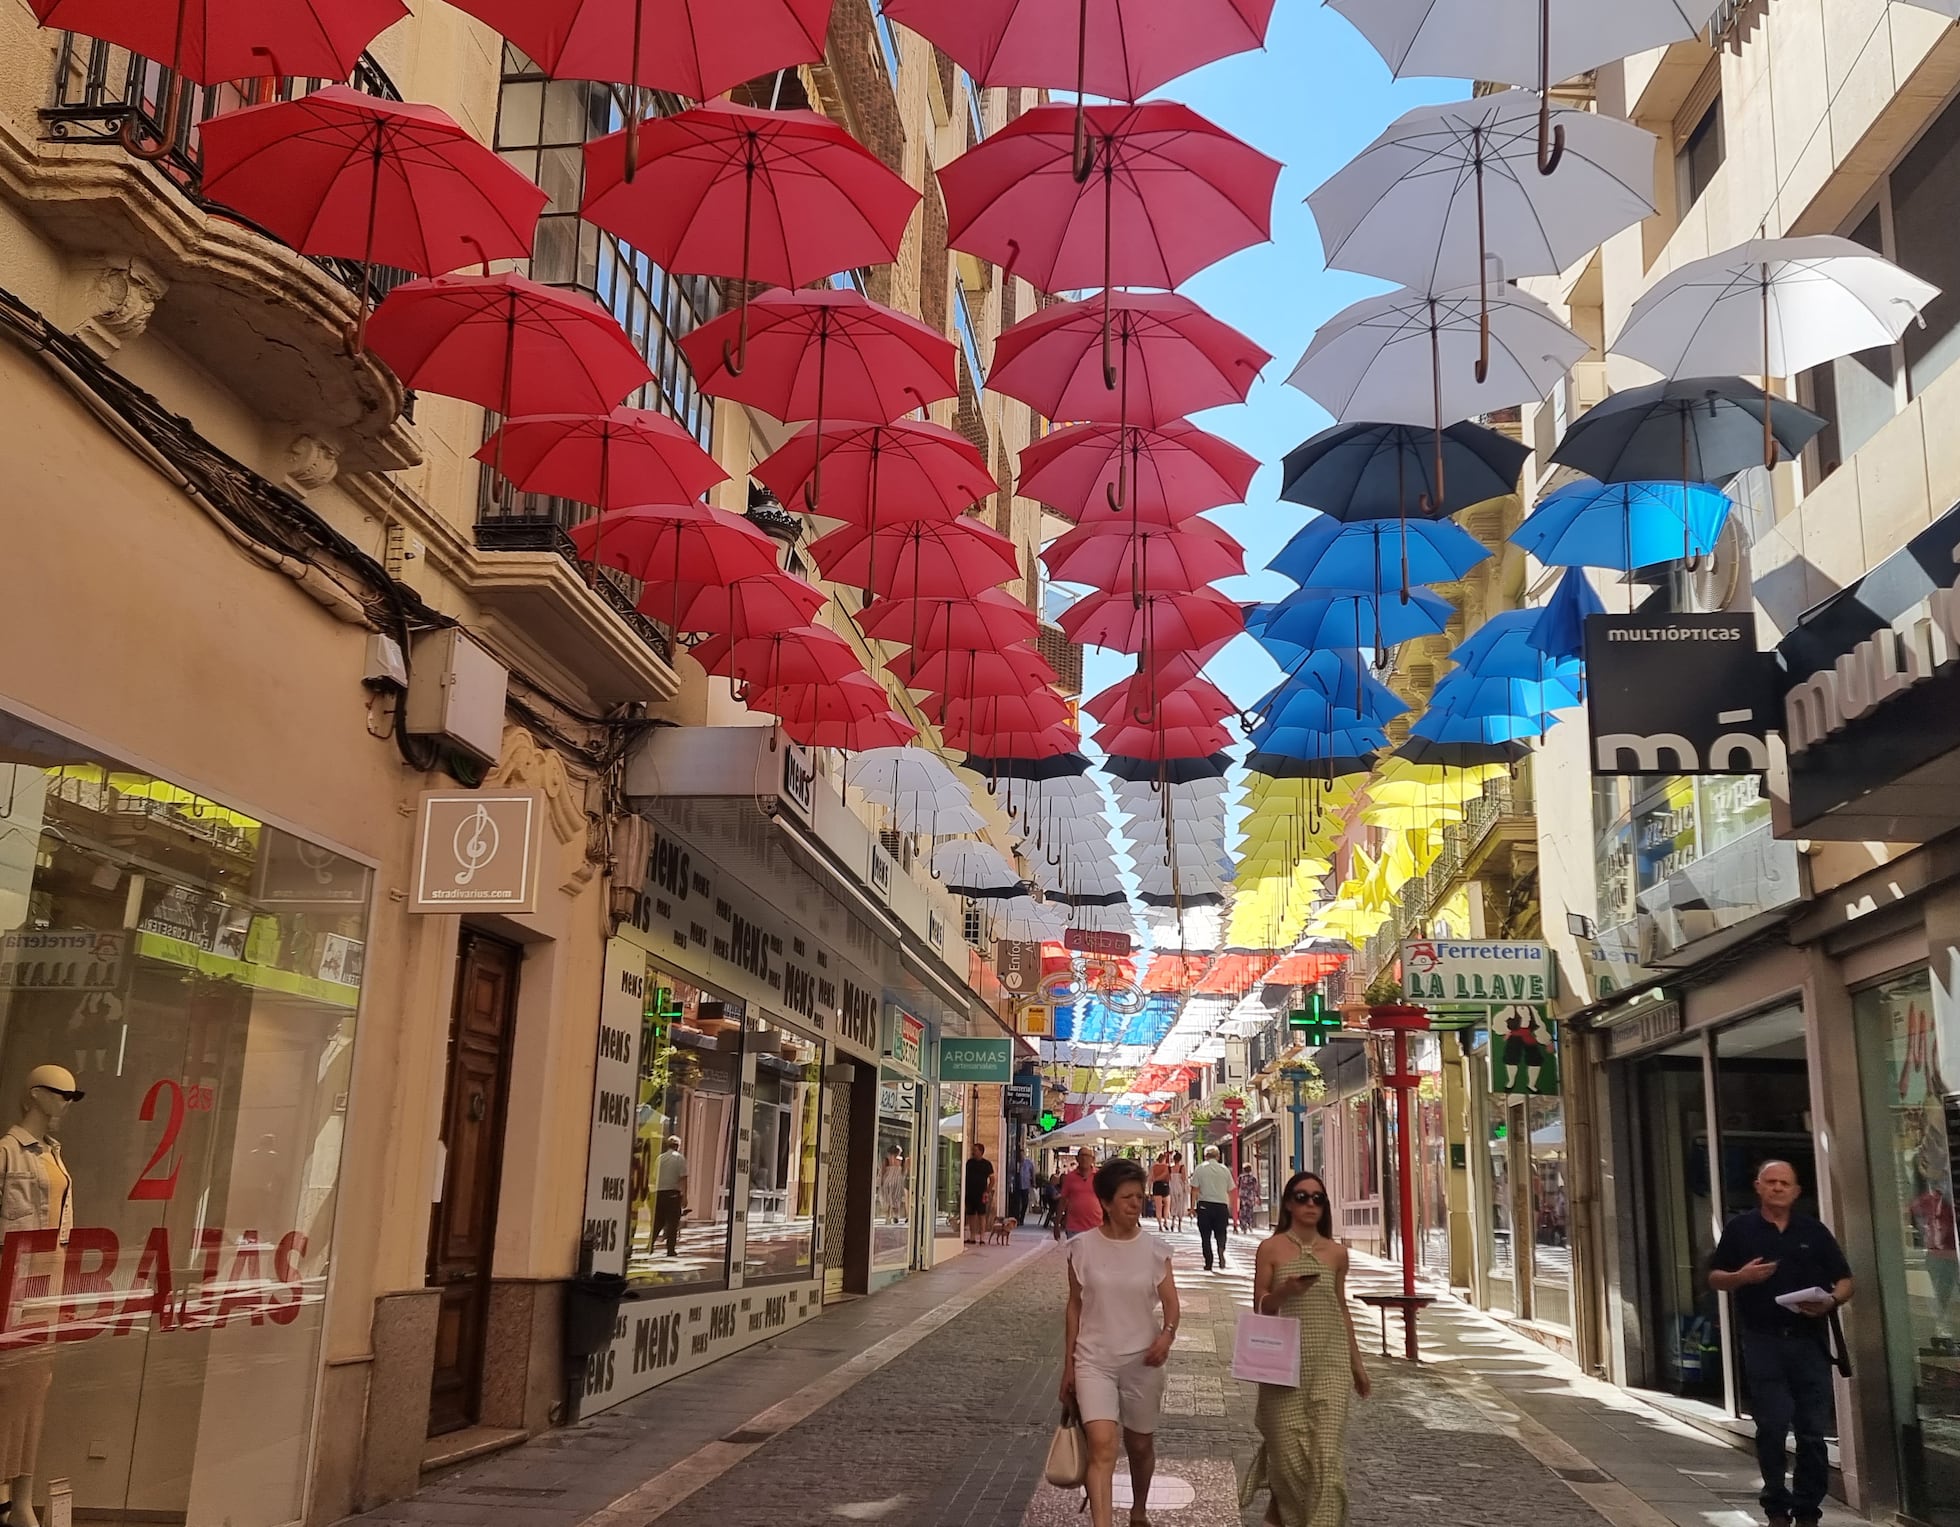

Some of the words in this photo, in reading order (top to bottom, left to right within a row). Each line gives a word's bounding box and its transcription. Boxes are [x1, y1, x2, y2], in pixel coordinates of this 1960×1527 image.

[431, 889, 512, 899] stradivarius.com
[1436, 943, 1542, 961] Ferreteria
[1408, 972, 1446, 999] LA
[1454, 973, 1545, 1000] LLAVE
[944, 1051, 1008, 1063] AROMAS
